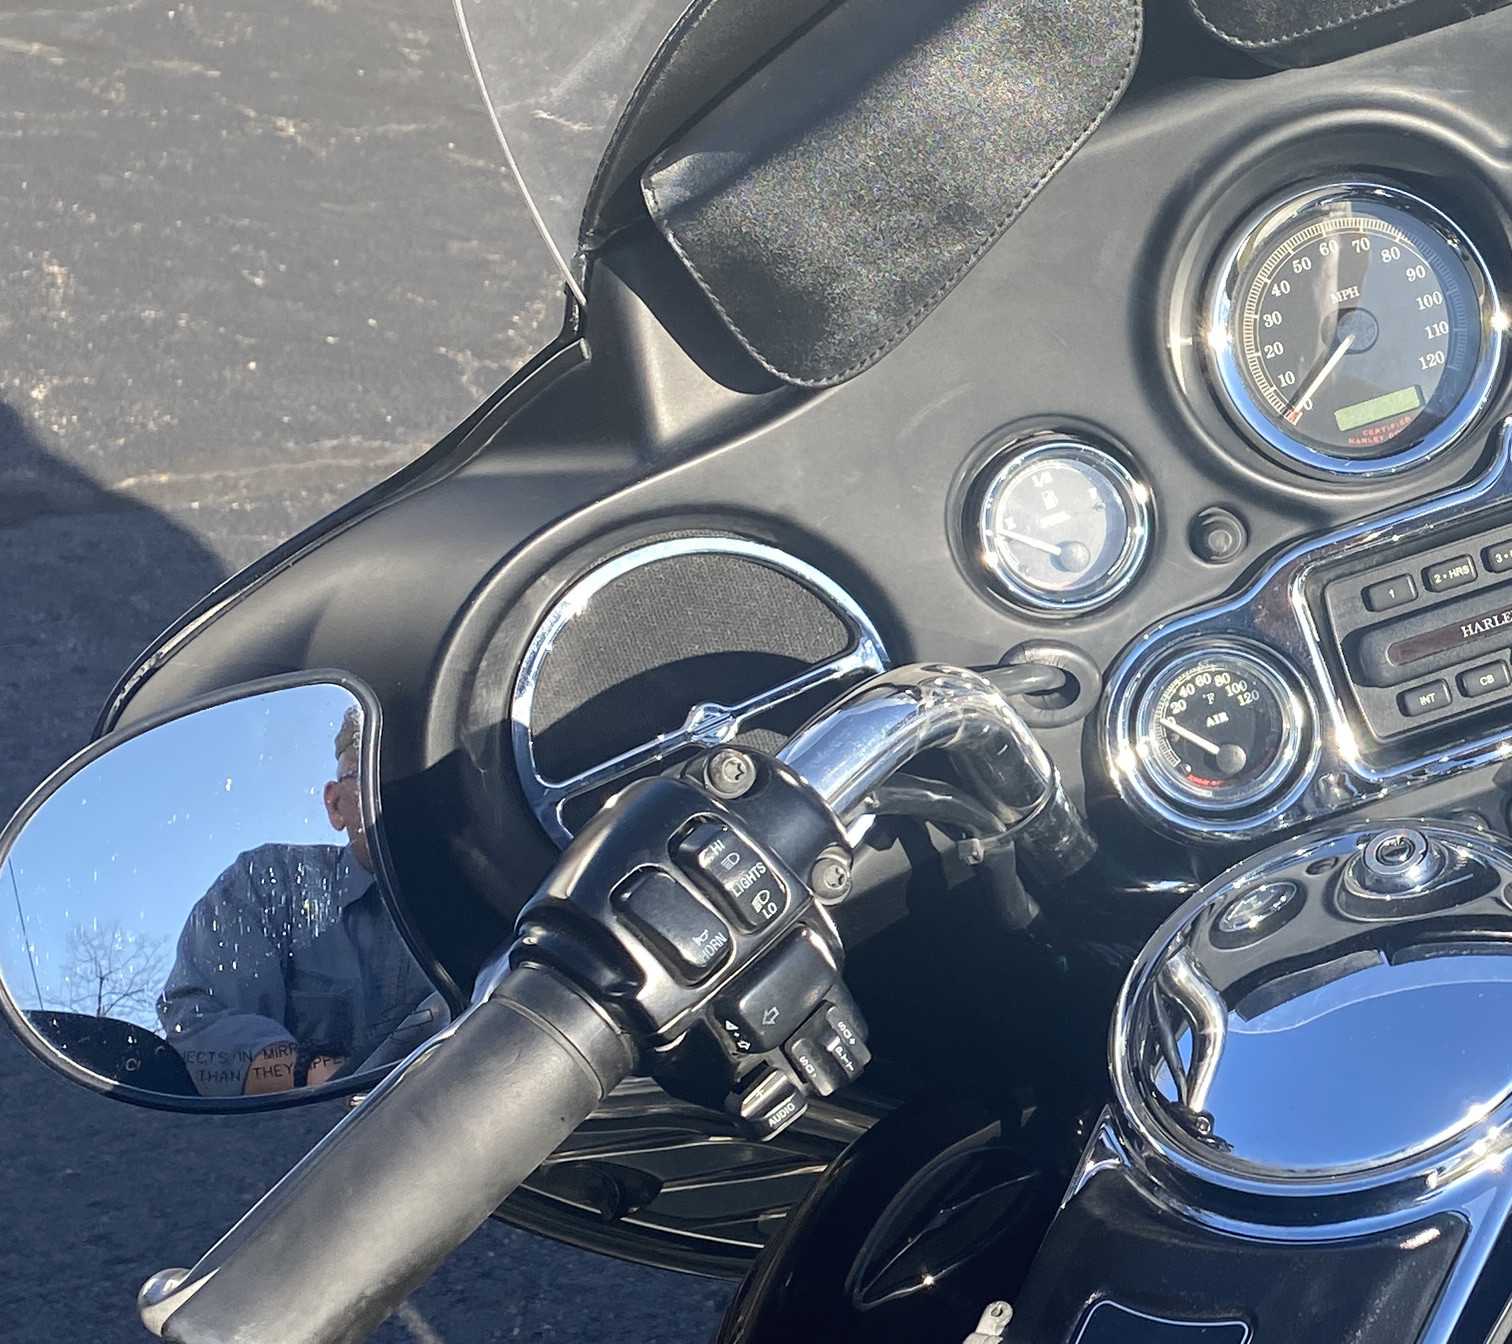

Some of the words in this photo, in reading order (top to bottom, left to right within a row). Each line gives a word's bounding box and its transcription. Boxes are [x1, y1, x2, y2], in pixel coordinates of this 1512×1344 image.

[1318, 239, 1339, 257] 60
[1351, 237, 1371, 254] 70
[1380, 246, 1401, 264] 80
[1292, 257, 1312, 274] 50
[1405, 265, 1426, 283] 90
[1271, 280, 1291, 298] 40
[1330, 285, 1360, 305] MPH
[1415, 291, 1443, 311] 100
[1262, 311, 1283, 328] 30
[1424, 321, 1449, 339] 110
[1264, 341, 1284, 359] 20
[1418, 350, 1445, 370] 120
[1279, 371, 1295, 388] 10
[1195, 673, 1212, 687] 60
[1214, 672, 1231, 687] 80
[1480, 673, 1494, 685] CB
[1179, 683, 1195, 698] 40
[1225, 680, 1248, 697] 100
[1170, 699, 1187, 715] 20
[1237, 689, 1260, 707] 120
[1419, 693, 1435, 706] INT
[1206, 712, 1230, 728] AIR
[711, 839, 725, 855] HI
[731, 861, 767, 897] LIGHTS
[762, 902, 777, 919] LO
[701, 931, 728, 961] HORN
[263, 1042, 299, 1060] MIRR
[835, 1046, 854, 1072] PTT
[199, 1069, 241, 1083] THAN
[252, 1063, 293, 1079] THEY
[768, 1102, 796, 1127] AUDIO
